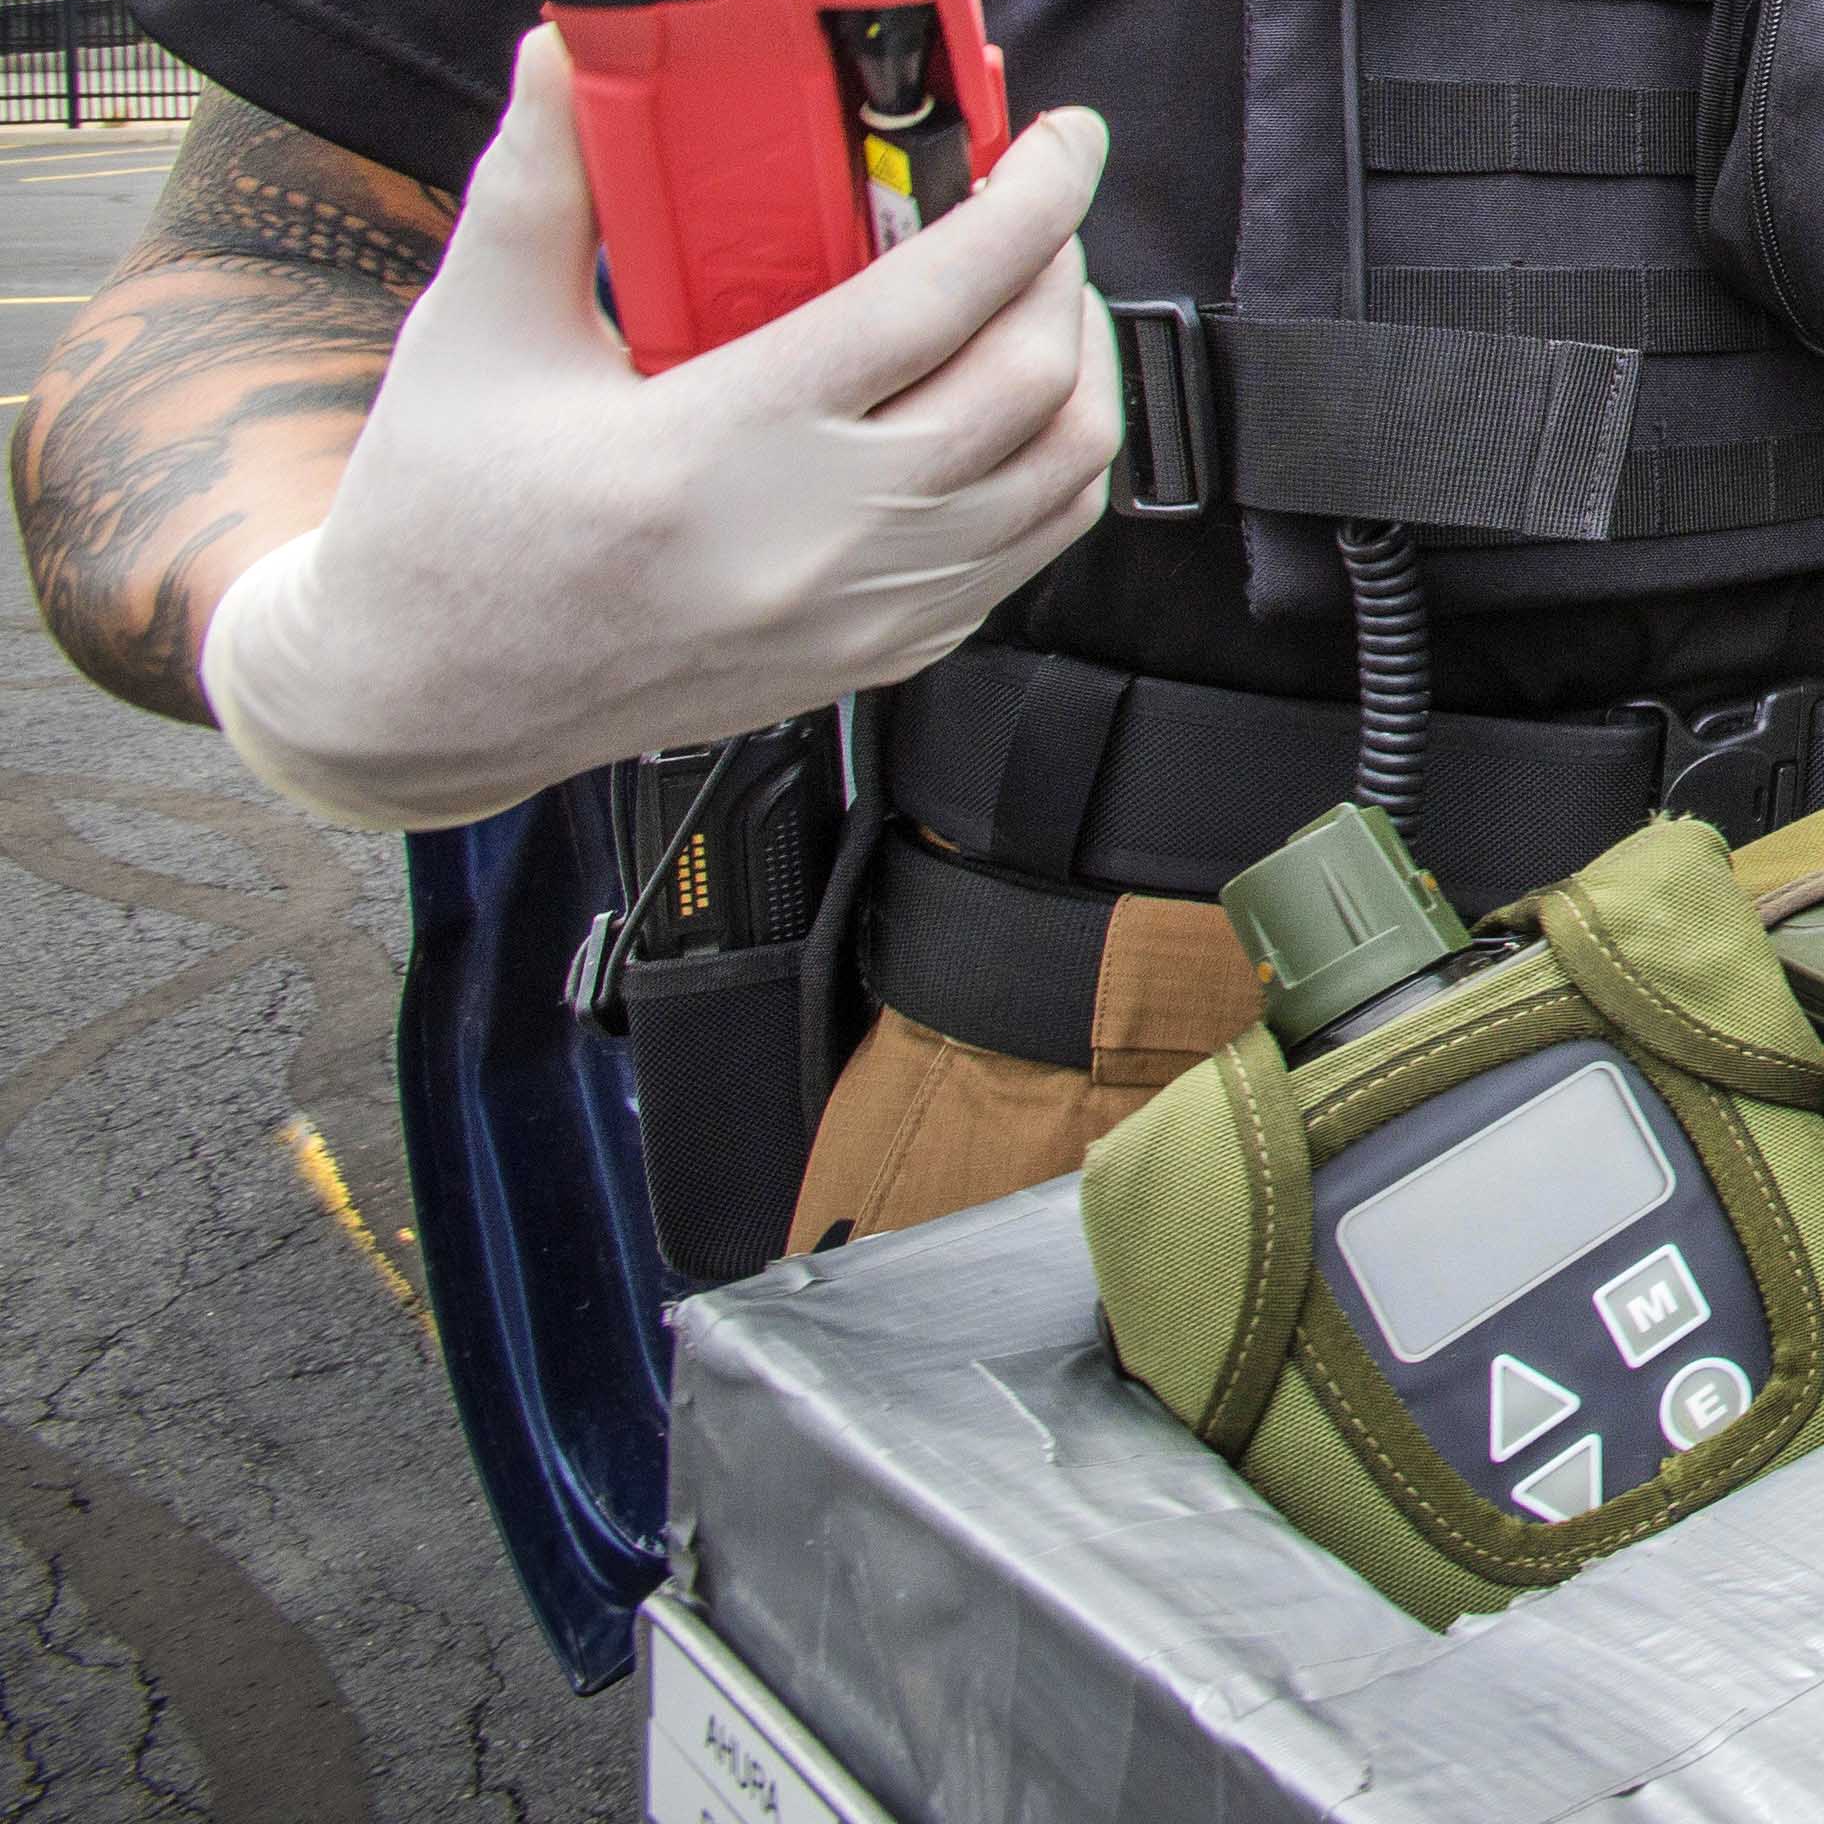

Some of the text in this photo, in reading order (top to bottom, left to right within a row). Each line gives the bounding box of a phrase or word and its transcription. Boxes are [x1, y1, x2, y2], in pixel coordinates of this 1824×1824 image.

[1626, 1280, 1678, 1334] M
[1684, 1383, 1729, 1430] E
[704, 1714, 778, 1815] AHURA
